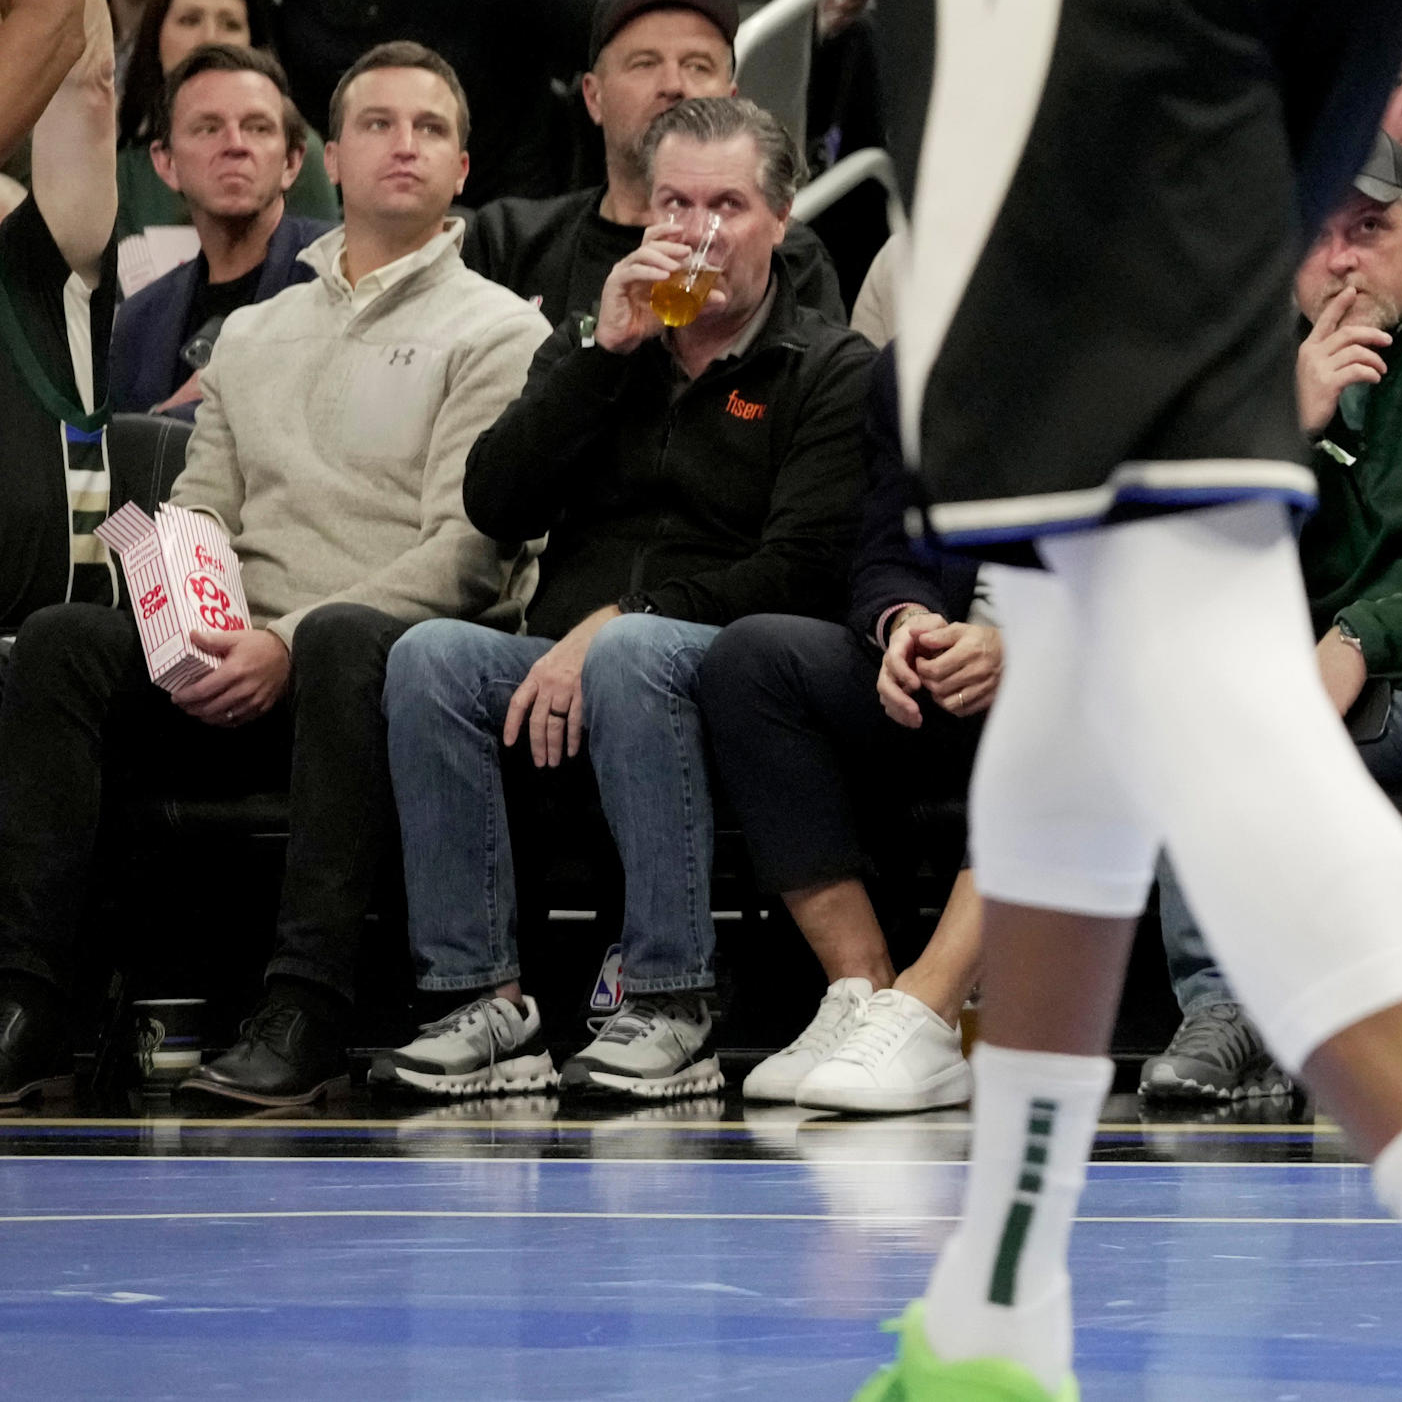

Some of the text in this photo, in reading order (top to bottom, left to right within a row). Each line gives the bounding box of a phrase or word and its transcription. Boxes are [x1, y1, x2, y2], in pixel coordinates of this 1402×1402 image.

[139, 583, 162, 610] POP
[143, 594, 168, 620] CORN
[189, 576, 231, 612] POP
